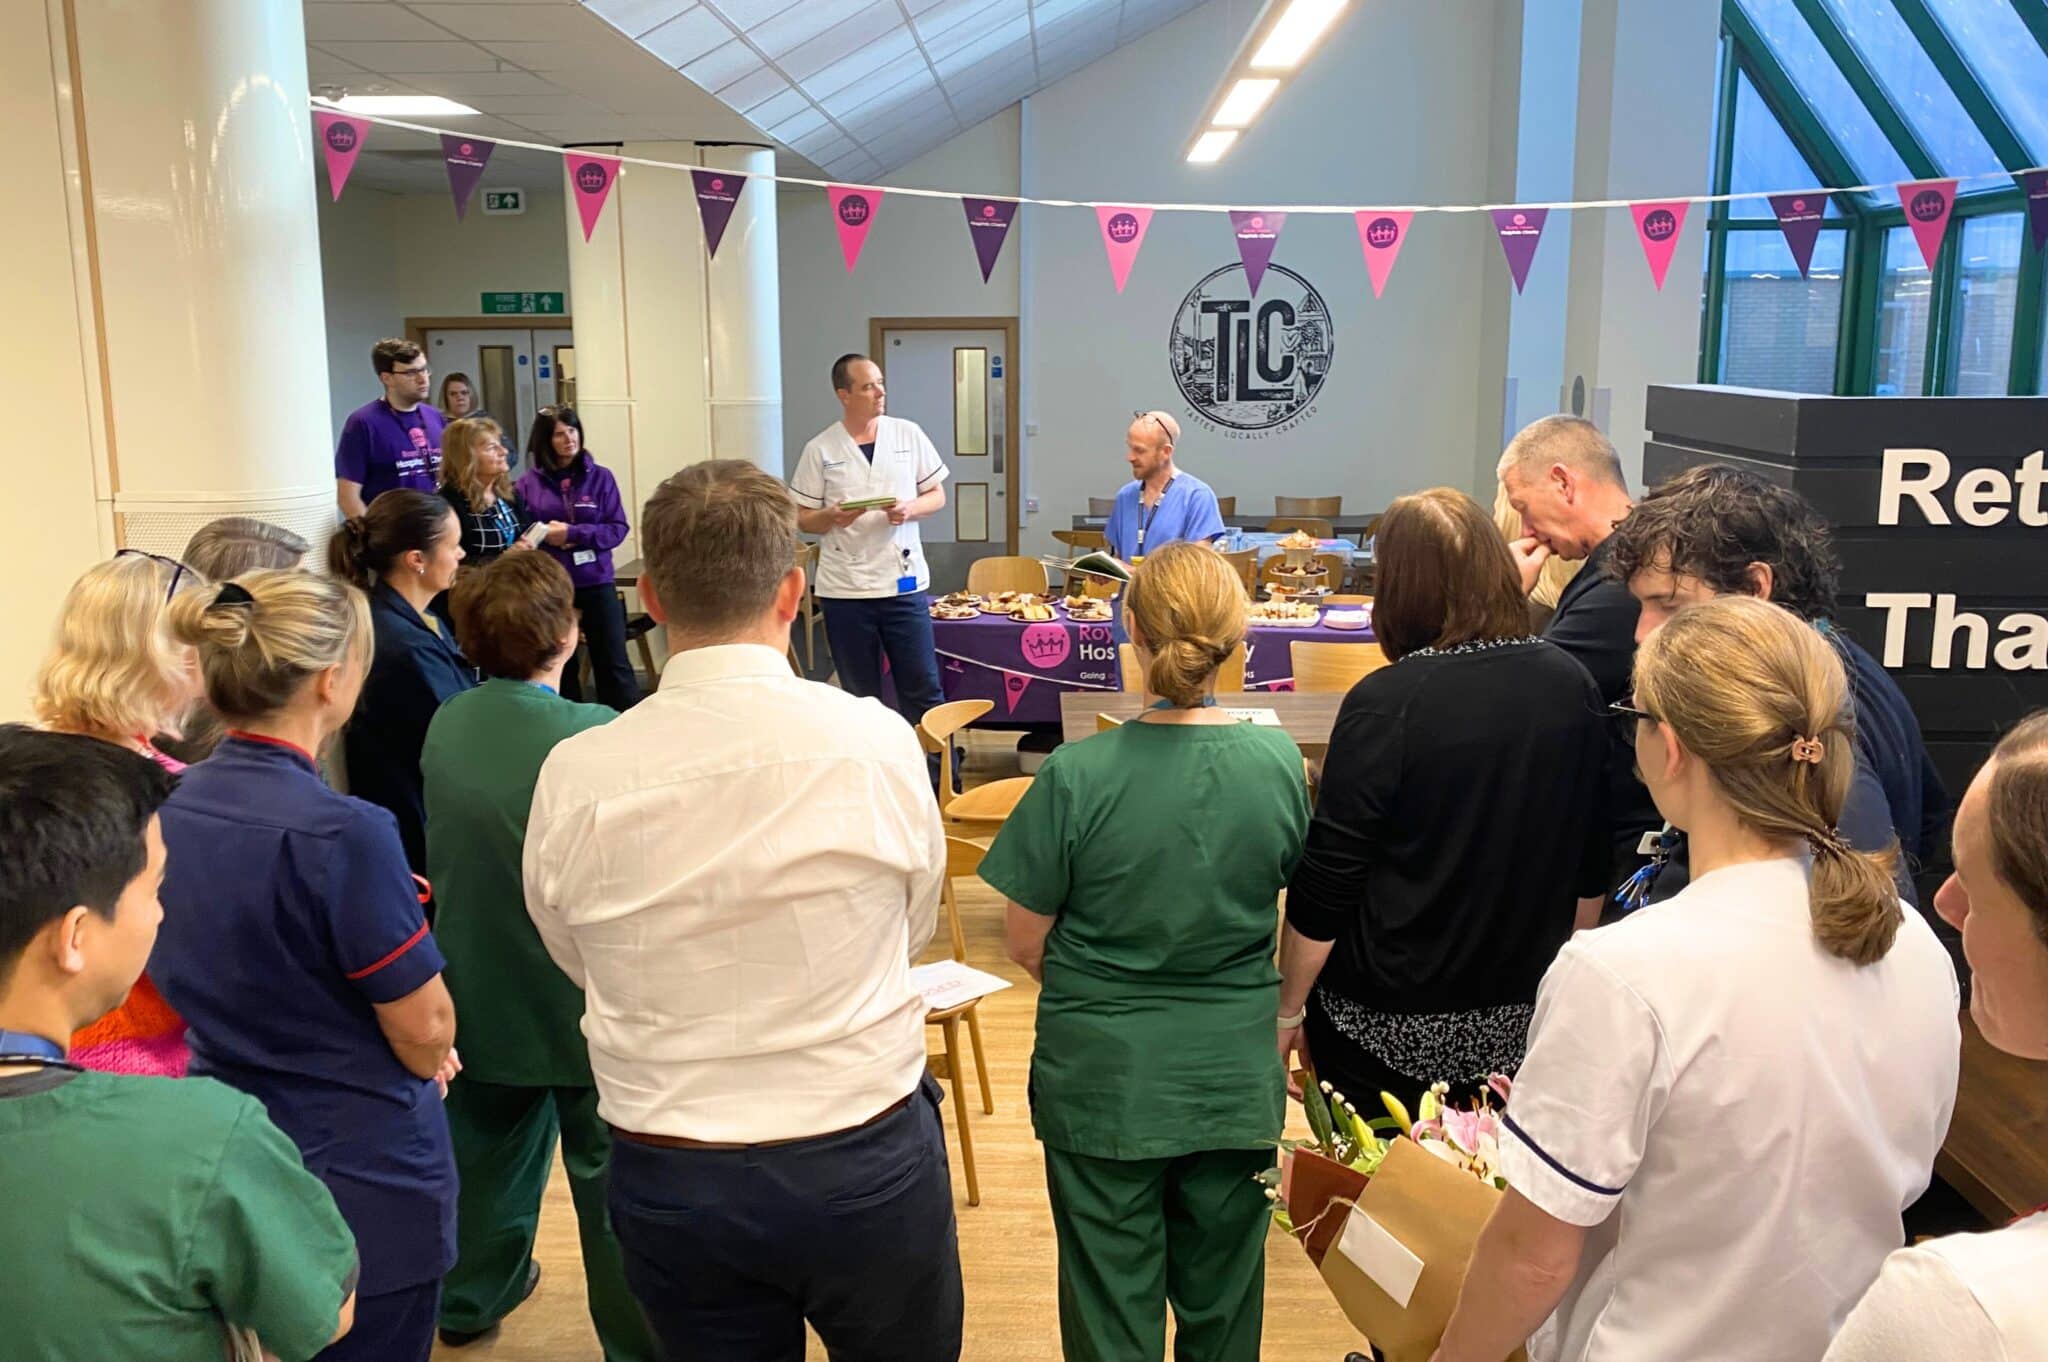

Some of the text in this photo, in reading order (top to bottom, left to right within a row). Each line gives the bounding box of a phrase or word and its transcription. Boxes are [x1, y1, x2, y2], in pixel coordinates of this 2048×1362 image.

[1200, 299, 1296, 402] TLC
[1183, 405, 1318, 440] TASTES LOCALLY CRAFTED
[1877, 448, 2048, 527] Ret
[1079, 623, 1113, 644] Roy
[1865, 592, 2048, 671] Tha
[1079, 643, 1116, 661] Hos
[1079, 671, 1106, 681] Going
